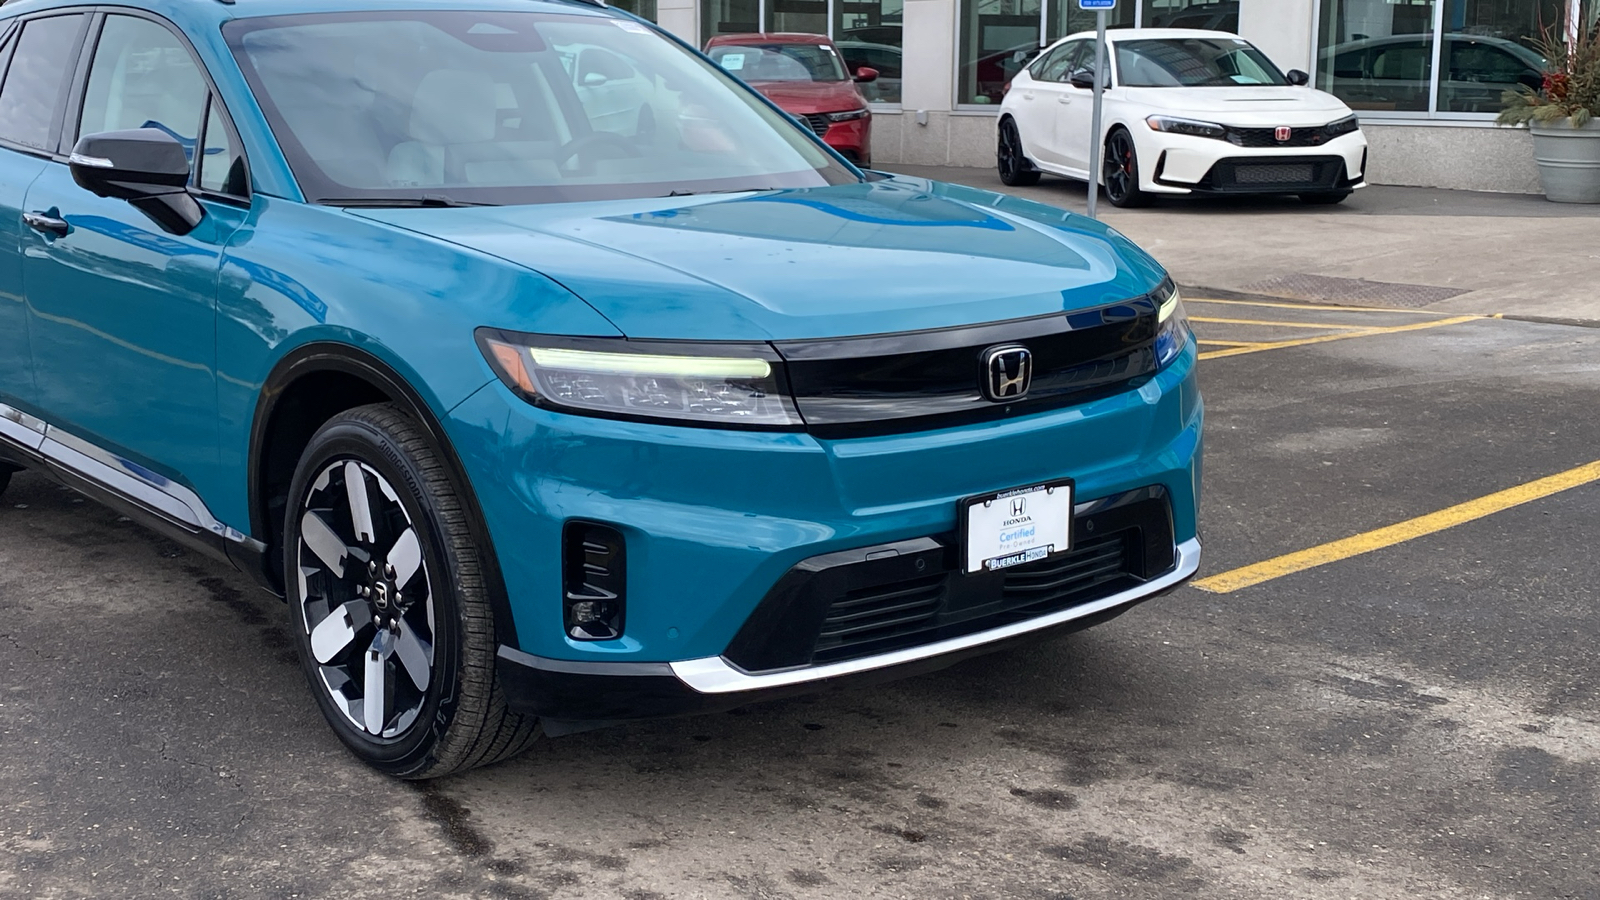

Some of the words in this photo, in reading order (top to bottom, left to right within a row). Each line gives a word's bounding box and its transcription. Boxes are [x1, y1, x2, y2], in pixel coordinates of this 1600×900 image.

[1003, 516, 1032, 526] HONDA
[1000, 527, 1035, 542] Certified
[1000, 538, 1035, 550] Pre-Owned
[991, 555, 1026, 568] BUERKLE
